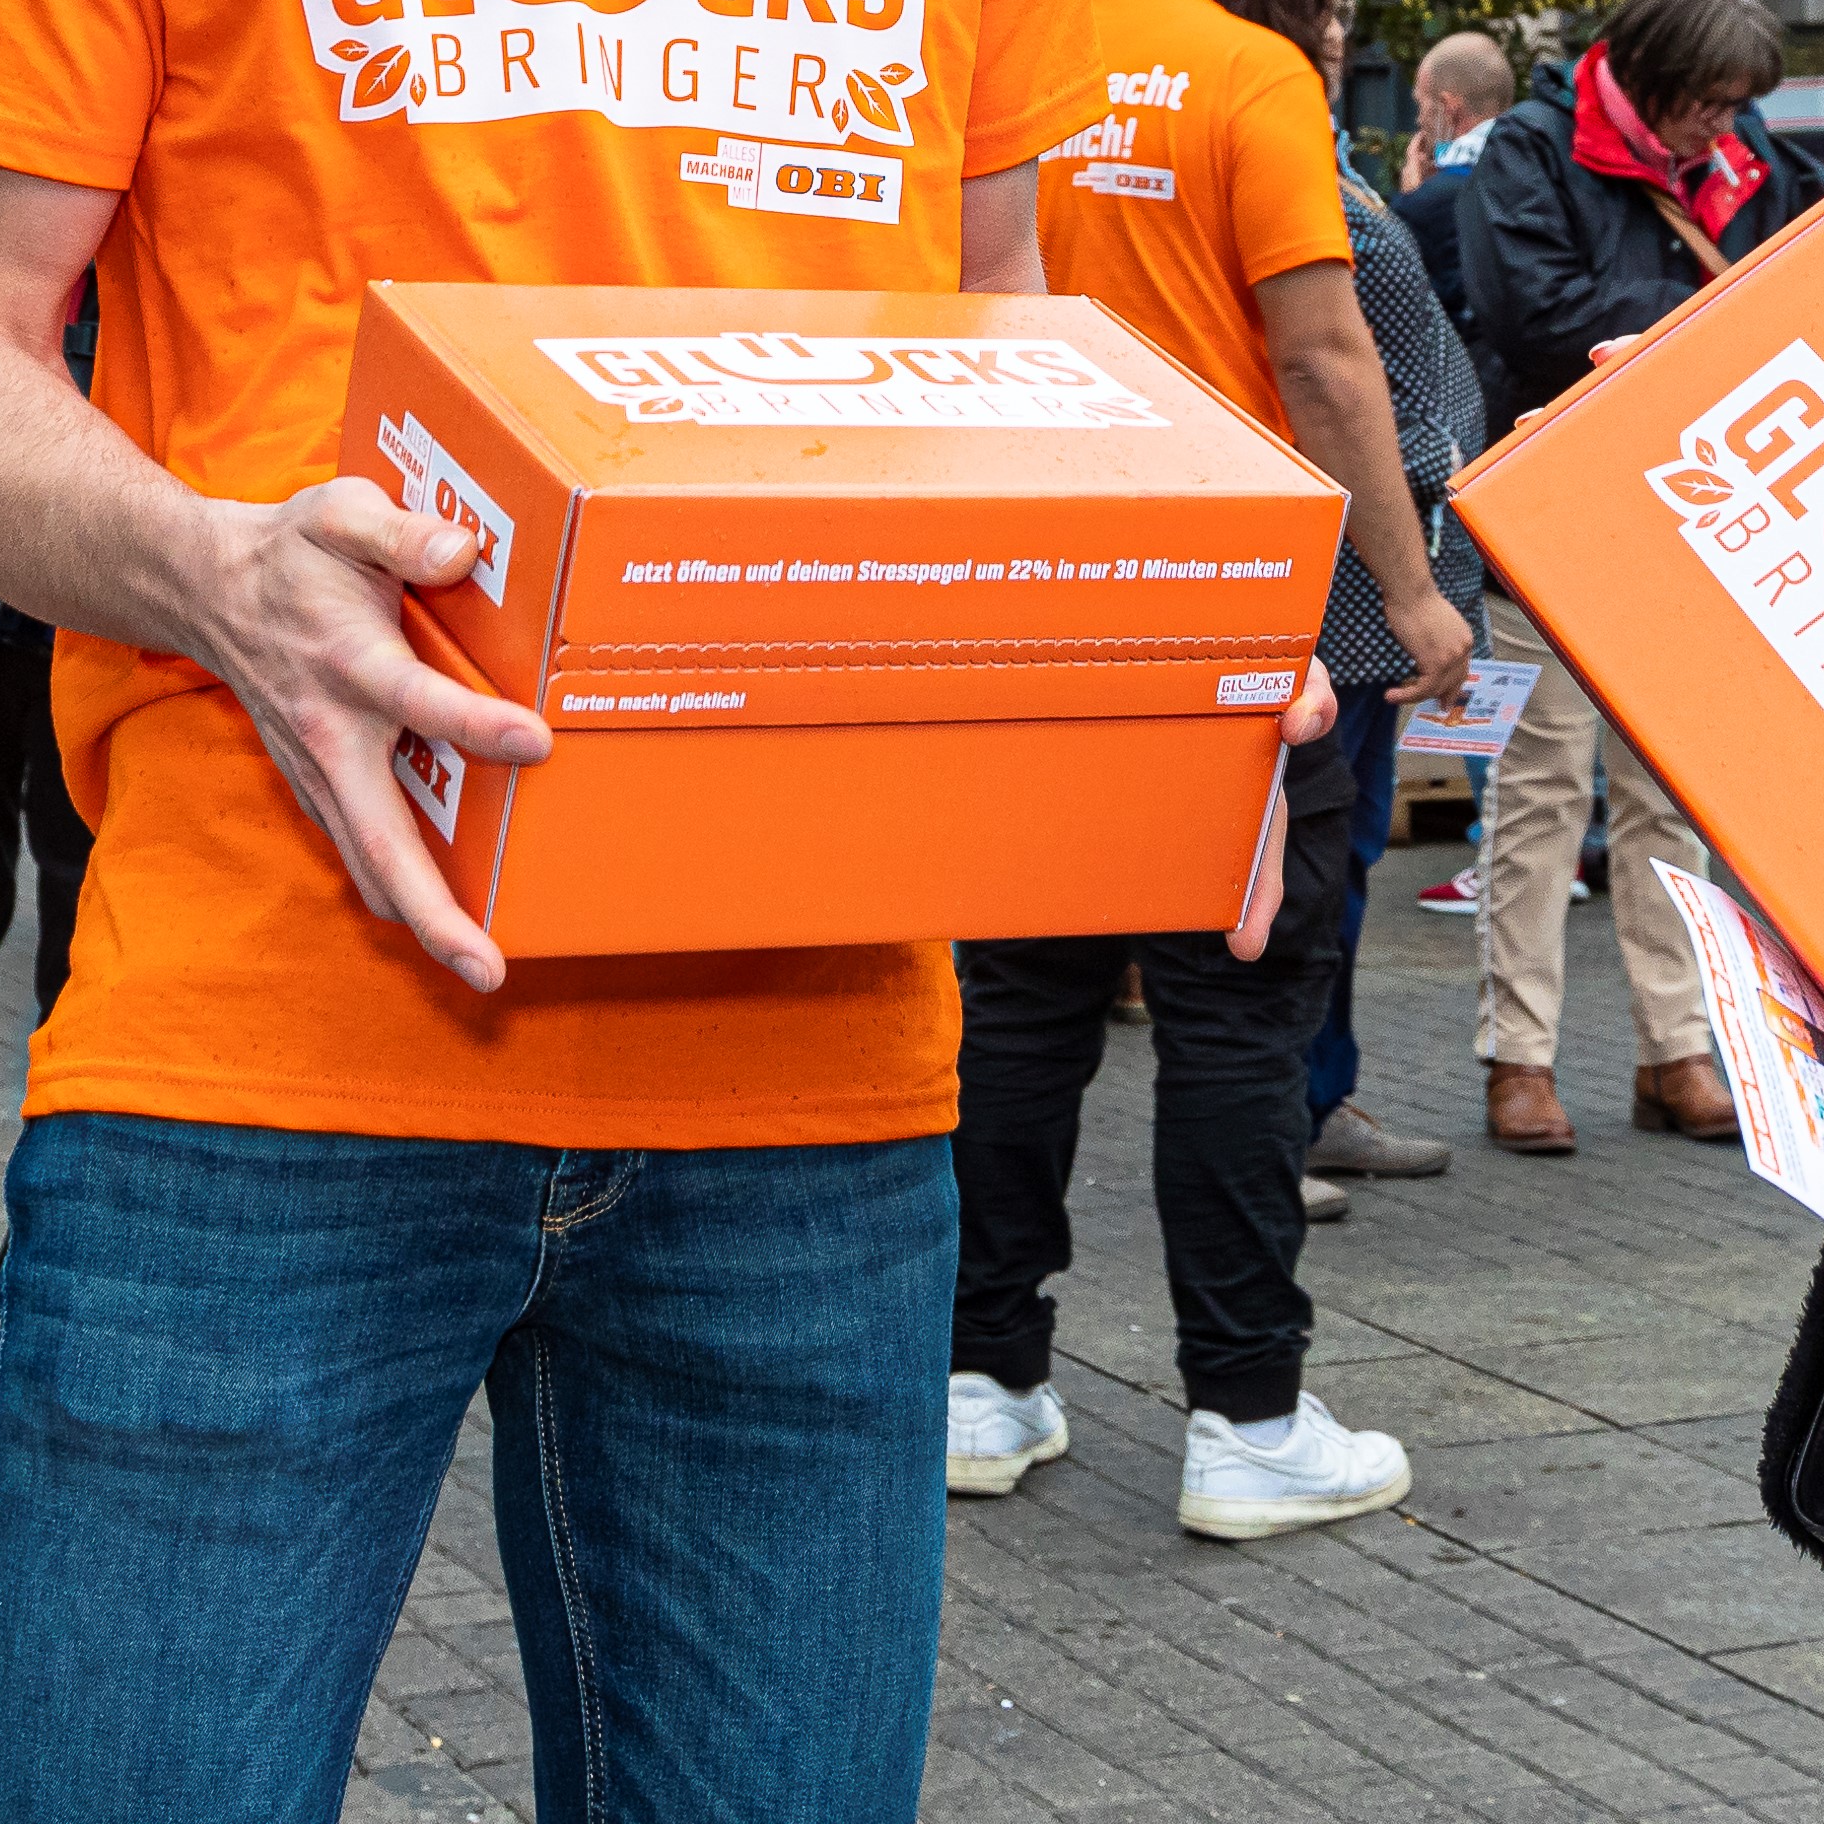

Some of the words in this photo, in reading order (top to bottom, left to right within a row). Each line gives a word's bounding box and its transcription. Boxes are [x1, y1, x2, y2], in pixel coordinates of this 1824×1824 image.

[431, 22, 827, 120] BRINGER
[1106, 63, 1191, 112] acht
[721, 143, 757, 163] ALLES
[686, 159, 754, 183] MACHBAR
[775, 163, 886, 203] OBI
[732, 185, 752, 203] MIT
[575, 337, 1097, 387] GLÜCKS
[696, 391, 1077, 417] BRINGER
[382, 426, 424, 483] MACHBAR
[622, 560, 673, 583] Jetzt
[677, 559, 741, 583] öffnen
[745, 559, 783, 582] und
[787, 559, 853, 582] deinen
[857, 558, 972, 585] Stresspegel
[975, 563, 1004, 581] um
[1008, 559, 1051, 581] 22%
[1056, 558, 1074, 581] in
[1078, 562, 1111, 581] nur
[1114, 558, 1138, 580] 30
[1142, 558, 1217, 580] Minuten
[1221, 557, 1293, 579] senken!
[1222, 674, 1292, 693] GLÜCKS
[562, 693, 616, 712] Garten
[618, 692, 669, 711] macht
[669, 691, 747, 714] glücklich!
